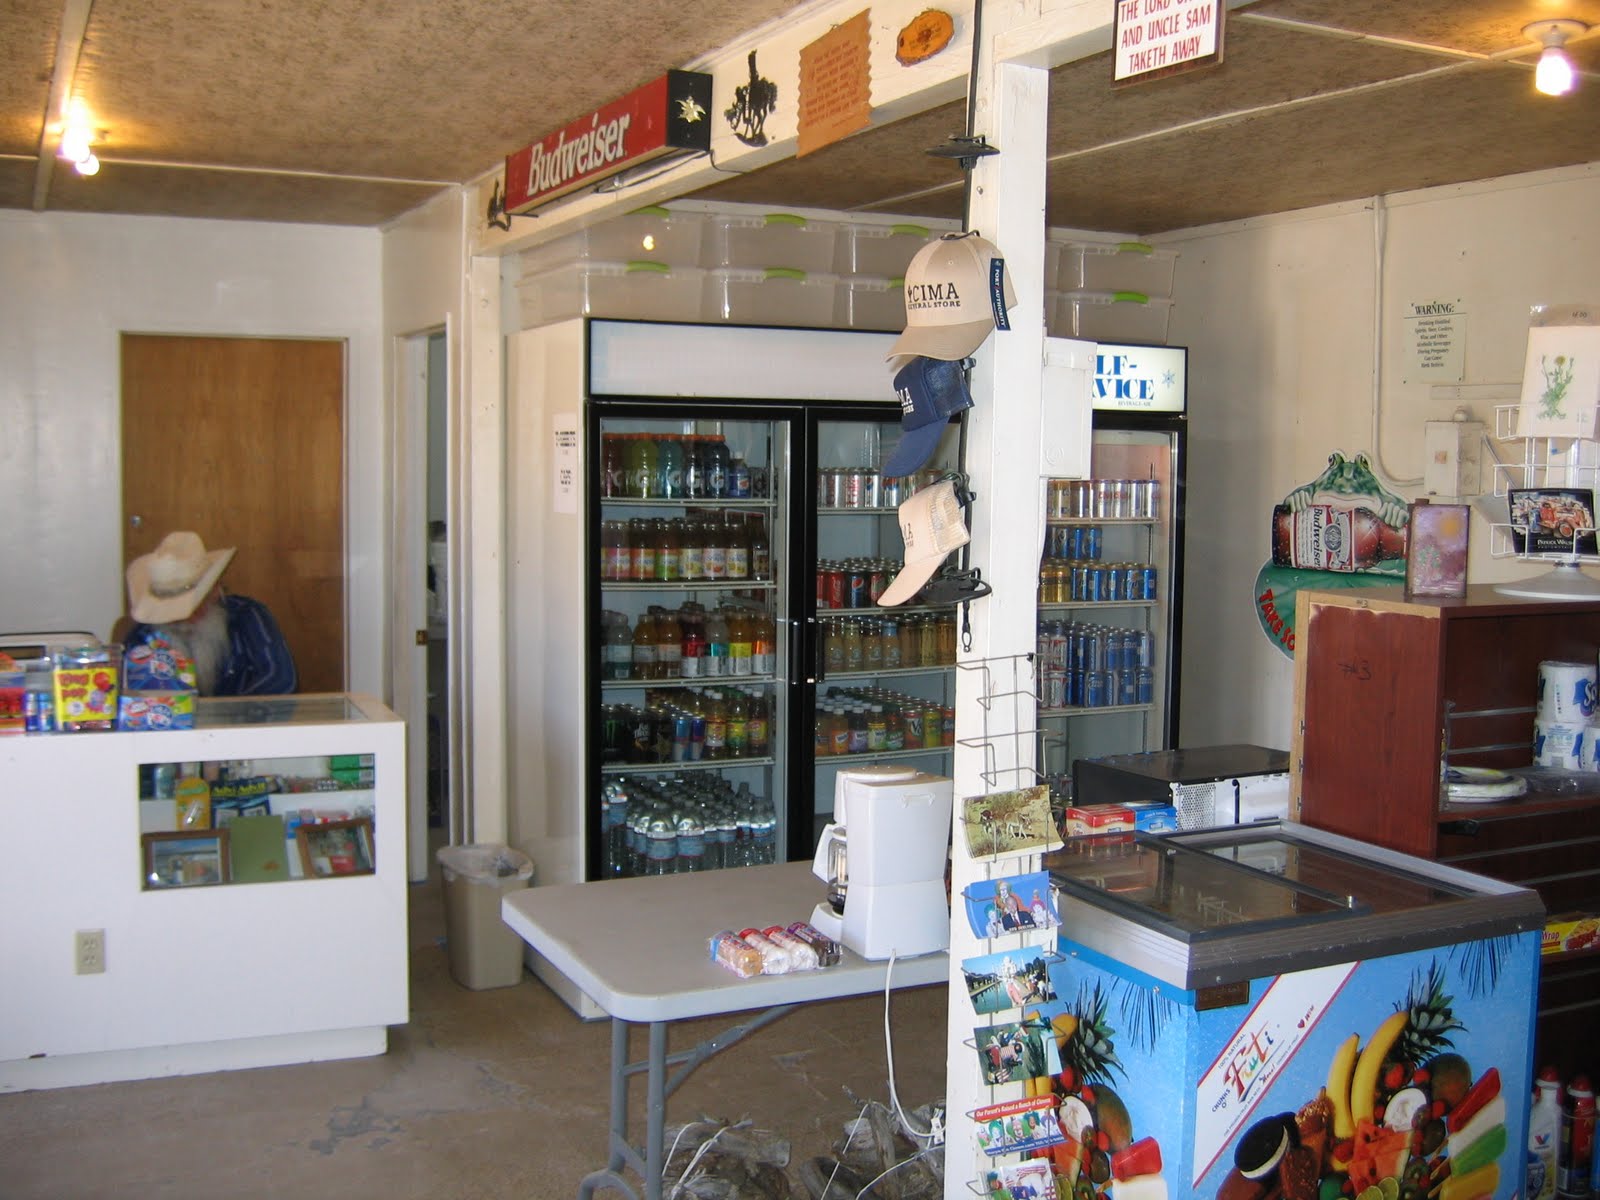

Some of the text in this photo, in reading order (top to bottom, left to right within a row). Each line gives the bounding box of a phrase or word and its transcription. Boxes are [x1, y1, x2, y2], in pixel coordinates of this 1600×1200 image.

[1121, 0, 1138, 22] THE
[1121, 4, 1211, 49] AND UNCLE SAM
[1128, 35, 1202, 73] TAKETH AWAY
[527, 112, 631, 196] Budweiser
[912, 282, 960, 302] CIMA
[933, 300, 961, 308] STORE
[995, 289, 1006, 328] AUTHORITY
[1415, 303, 1455, 315] WARNING:
[1096, 355, 1137, 376] LF-
[1093, 378, 1154, 400] VICE
[1313, 508, 1323, 569] Budweiser
[1259, 588, 1284, 636] TAKE
[1228, 1033, 1247, 1057] NATURAL
